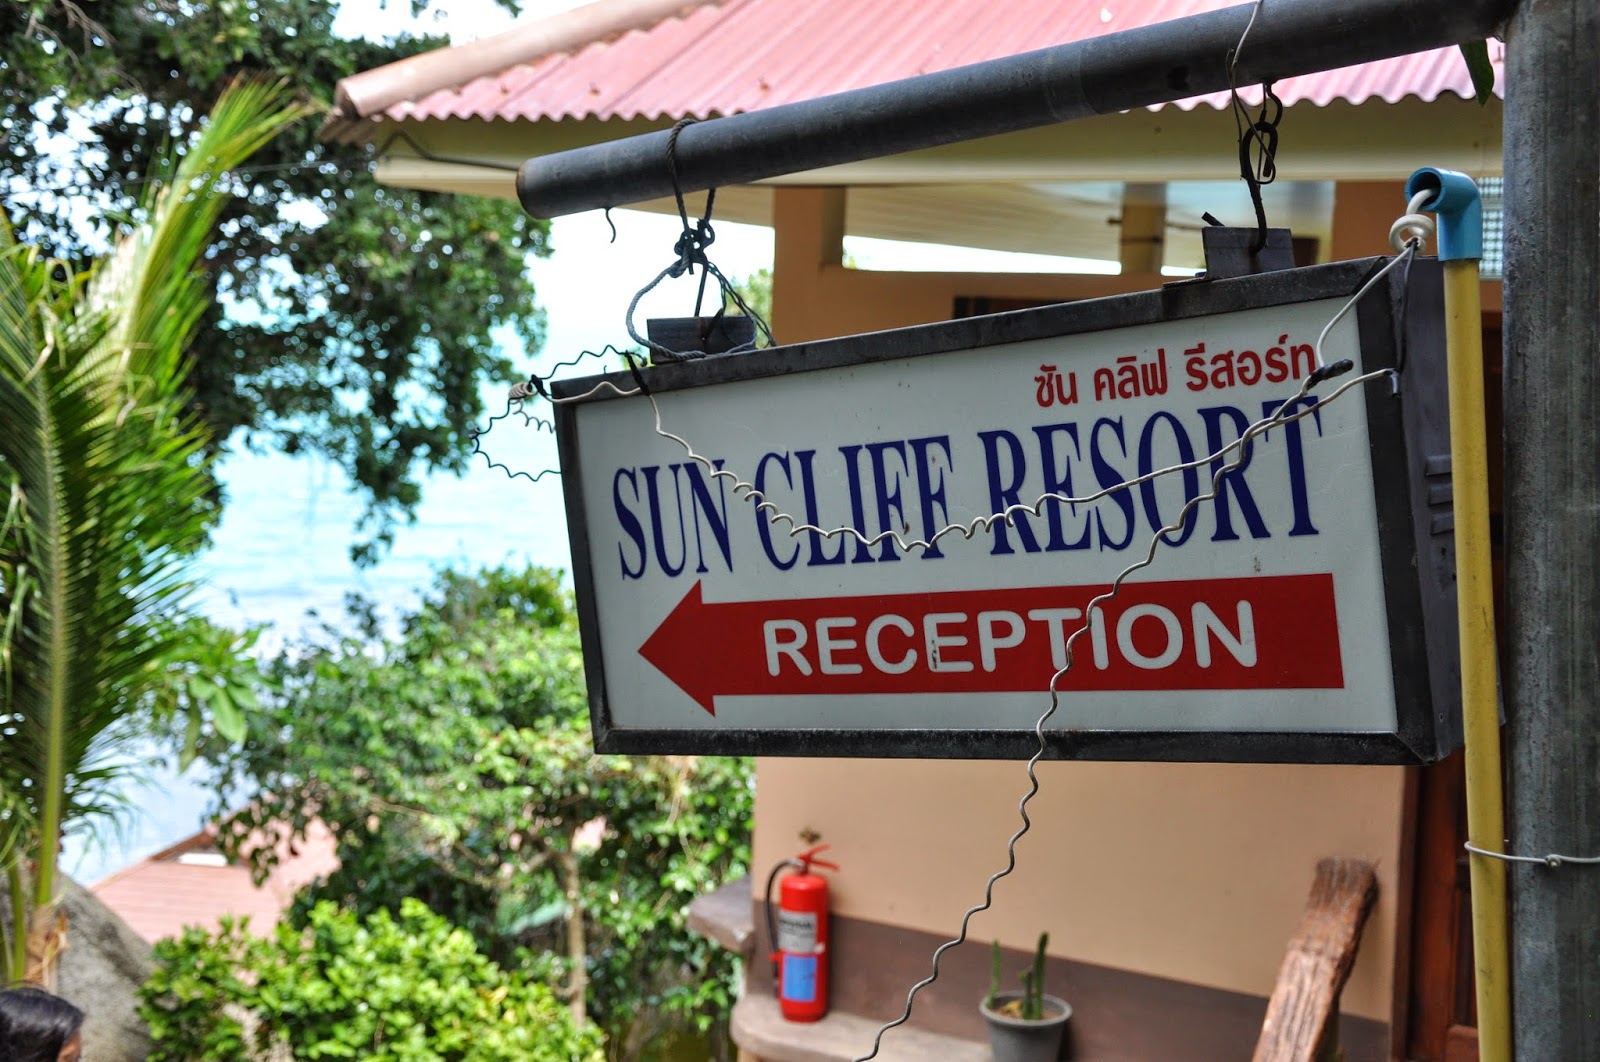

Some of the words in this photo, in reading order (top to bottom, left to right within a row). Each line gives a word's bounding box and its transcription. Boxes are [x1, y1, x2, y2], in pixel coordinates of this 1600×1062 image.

[1034, 364, 1078, 408] ซัน
[1093, 348, 1168, 402] คลิฟ
[1184, 334, 1316, 391] รีสอร์ท
[612, 458, 734, 580] SUN
[753, 434, 953, 571] CLIFF
[977, 395, 1323, 556] RESORT
[762, 599, 1258, 677] RECEPTION
